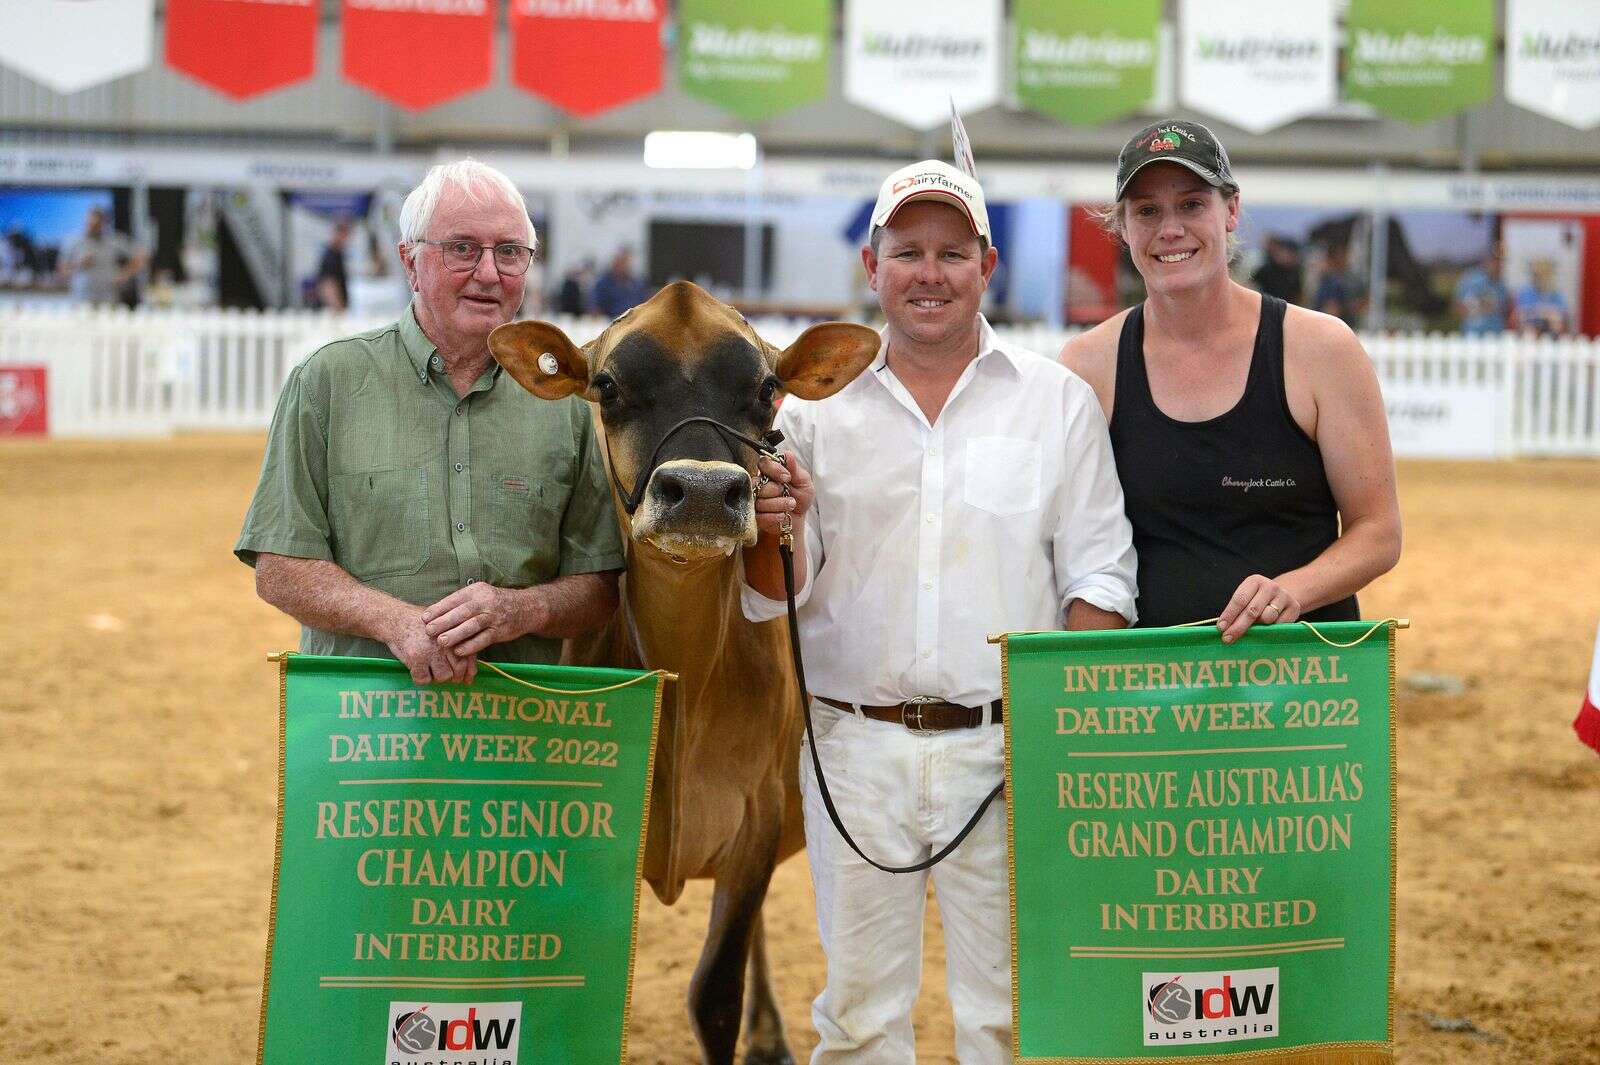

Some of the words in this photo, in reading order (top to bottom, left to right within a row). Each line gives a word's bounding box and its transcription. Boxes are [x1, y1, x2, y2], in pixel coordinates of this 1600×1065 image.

[1265, 478, 1285, 487] Cattle
[1063, 655, 1348, 693] INTERNATIONAL
[338, 690, 612, 727] INTERNATIONAL
[1055, 706, 1161, 735] DAIRY
[1171, 702, 1275, 732] WEEK
[1284, 699, 1361, 729] 2022
[328, 734, 432, 763] DAIRY
[441, 734, 538, 763] WEEK
[546, 738, 619, 768] 2022
[1056, 770, 1179, 809] RESERVE
[1186, 763, 1364, 809] AUSTRALIA'S
[315, 799, 471, 839] RESERVE
[480, 799, 616, 838] SENIOR
[1068, 820, 1177, 858] GRAND
[1185, 814, 1353, 857] CHAMPION
[356, 848, 567, 887] CHAMPION
[1155, 867, 1263, 897] DAIRY
[411, 898, 517, 926] DAIRY
[1099, 899, 1317, 931] INTERBREED
[353, 932, 562, 961] INTERBREED
[1149, 1024, 1273, 1040] australia
